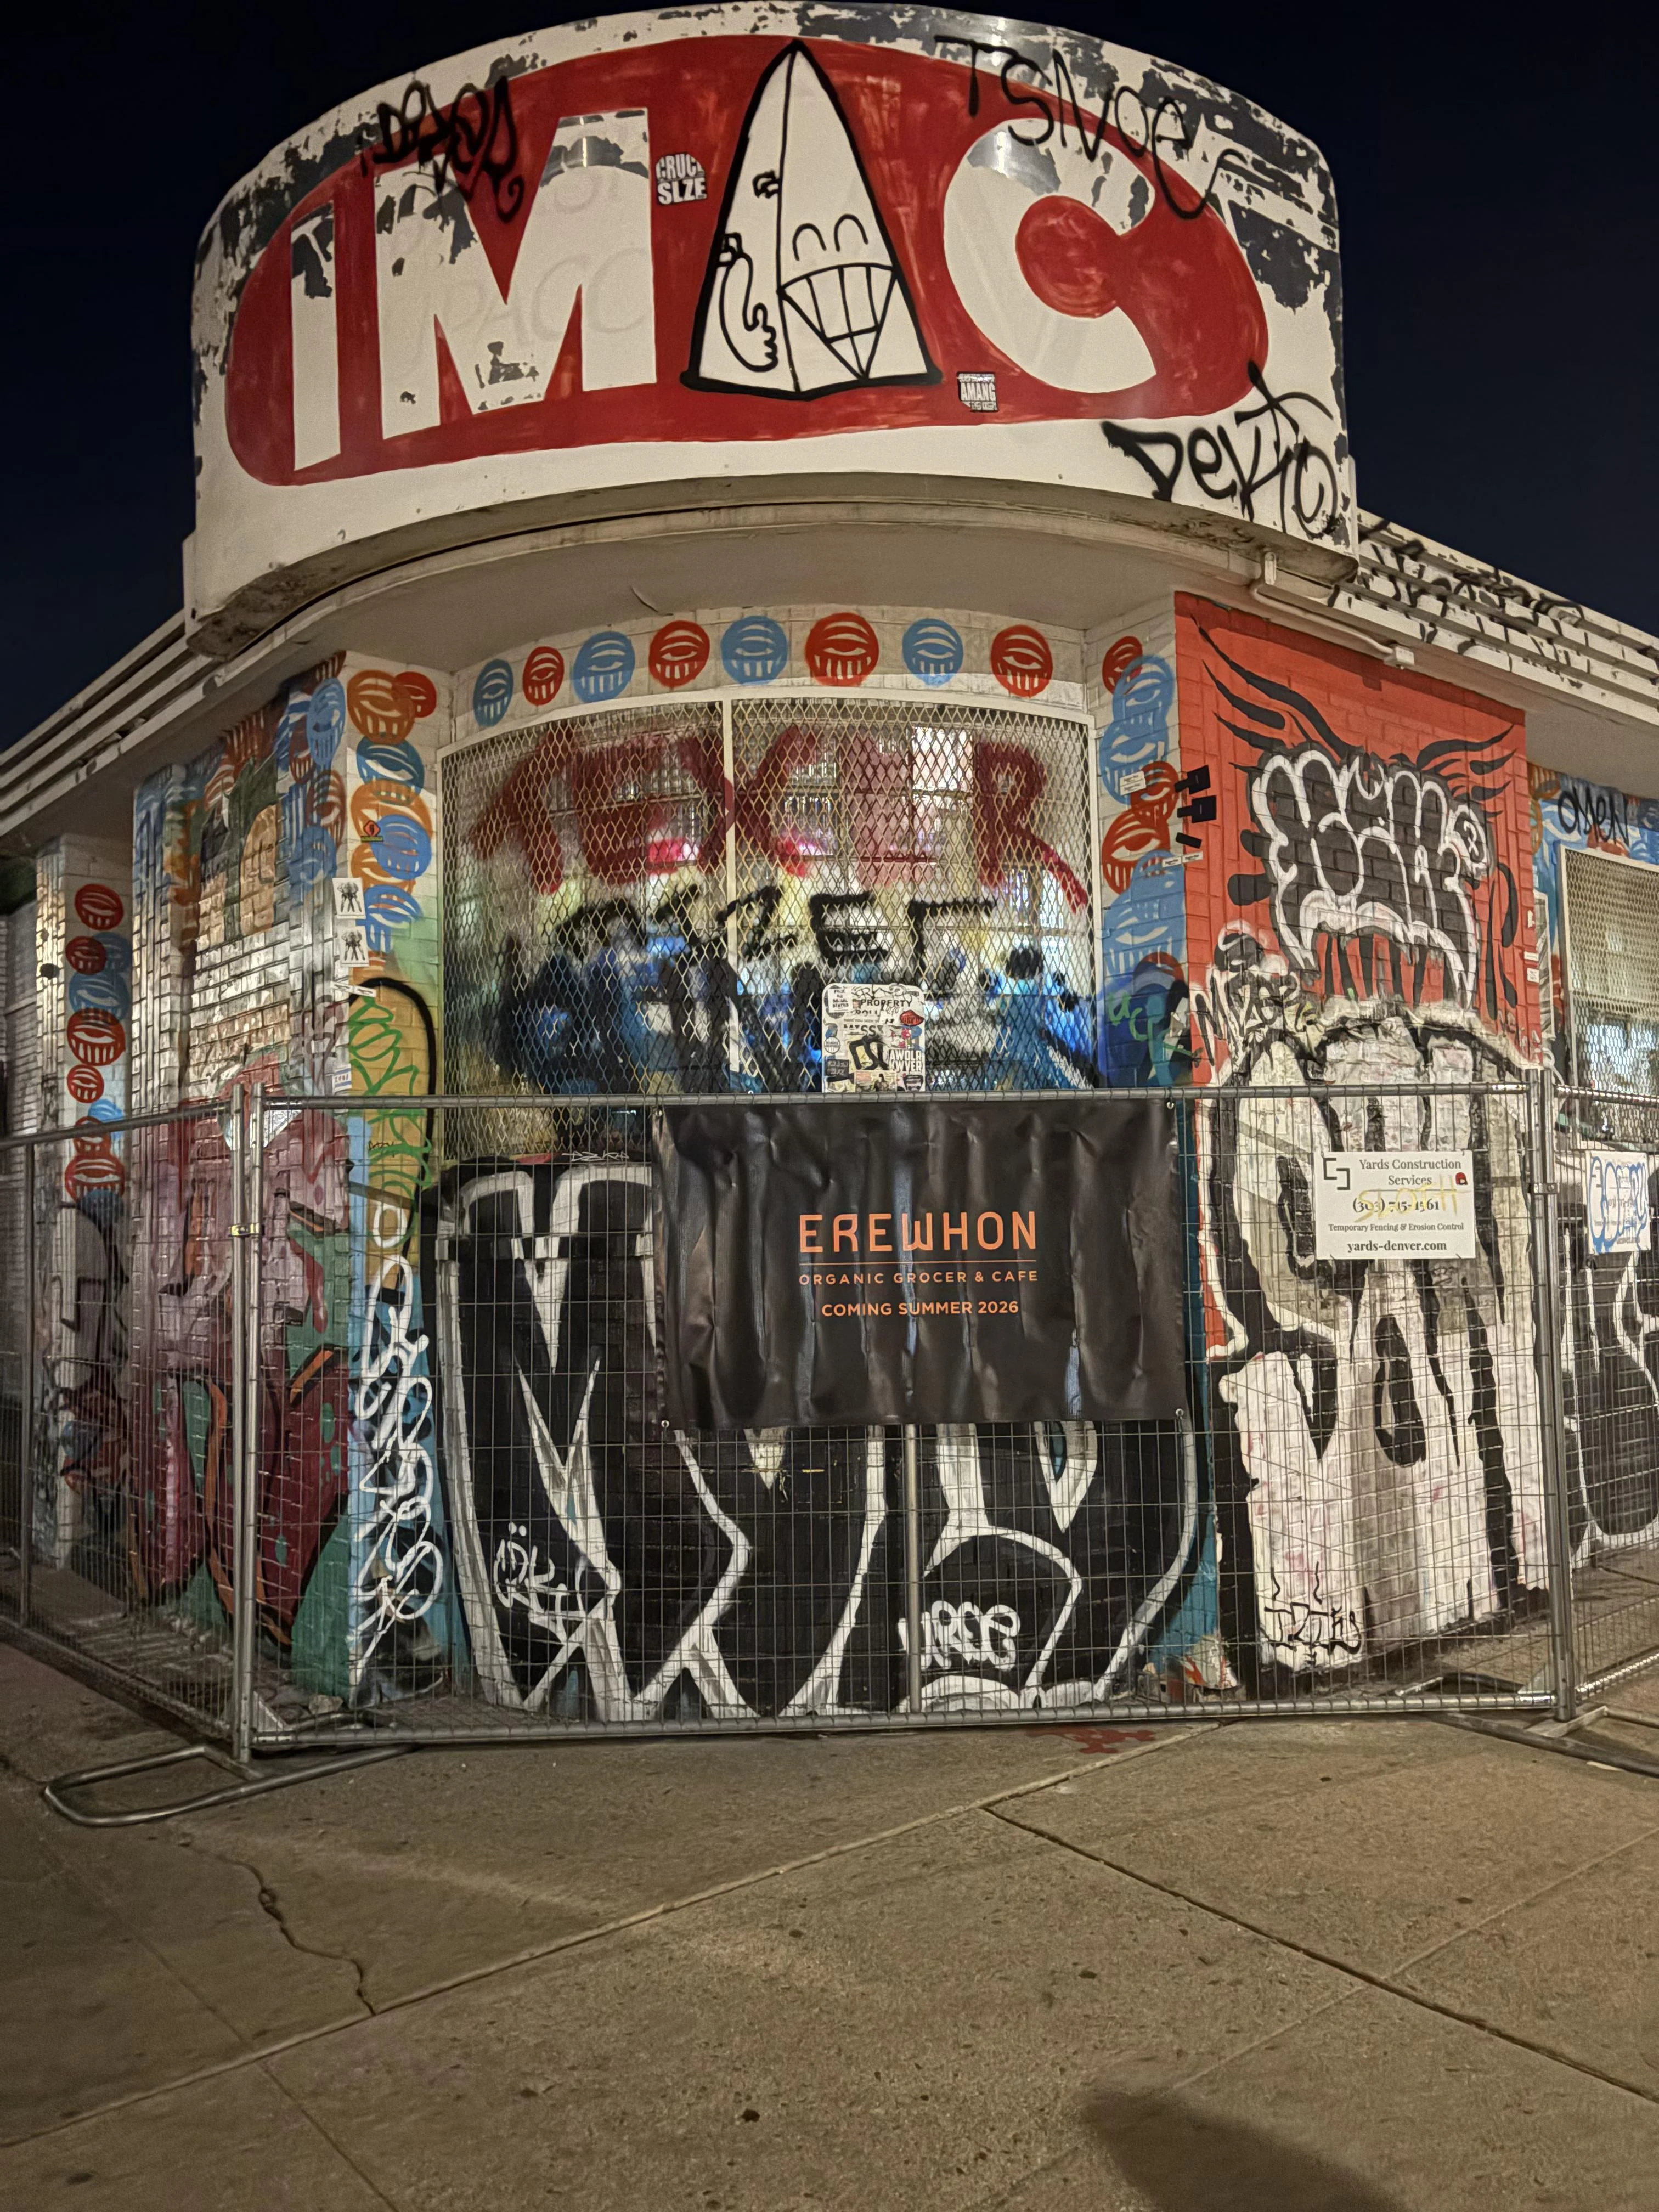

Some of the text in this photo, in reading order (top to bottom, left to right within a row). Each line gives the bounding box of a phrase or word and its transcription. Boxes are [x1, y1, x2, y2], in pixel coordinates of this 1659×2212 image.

[860, 998, 911, 1007] PROPERTY
[1359, 1158, 1462, 1170] Yards Construction
[1388, 1175, 1432, 1186] Services
[799, 1211, 1036, 1252] EREWHON
[1328, 1223, 1368, 1232] Temporary
[1370, 1223, 1398, 1232] Fencing
[1437, 1222, 1464, 1231] Control
[1347, 1240, 1447, 1253] yards-denver.com
[799, 1270, 1038, 1286] ORGANIC GROCER & CAFE
[822, 1300, 1019, 1317] COMING SUMMER 2026
